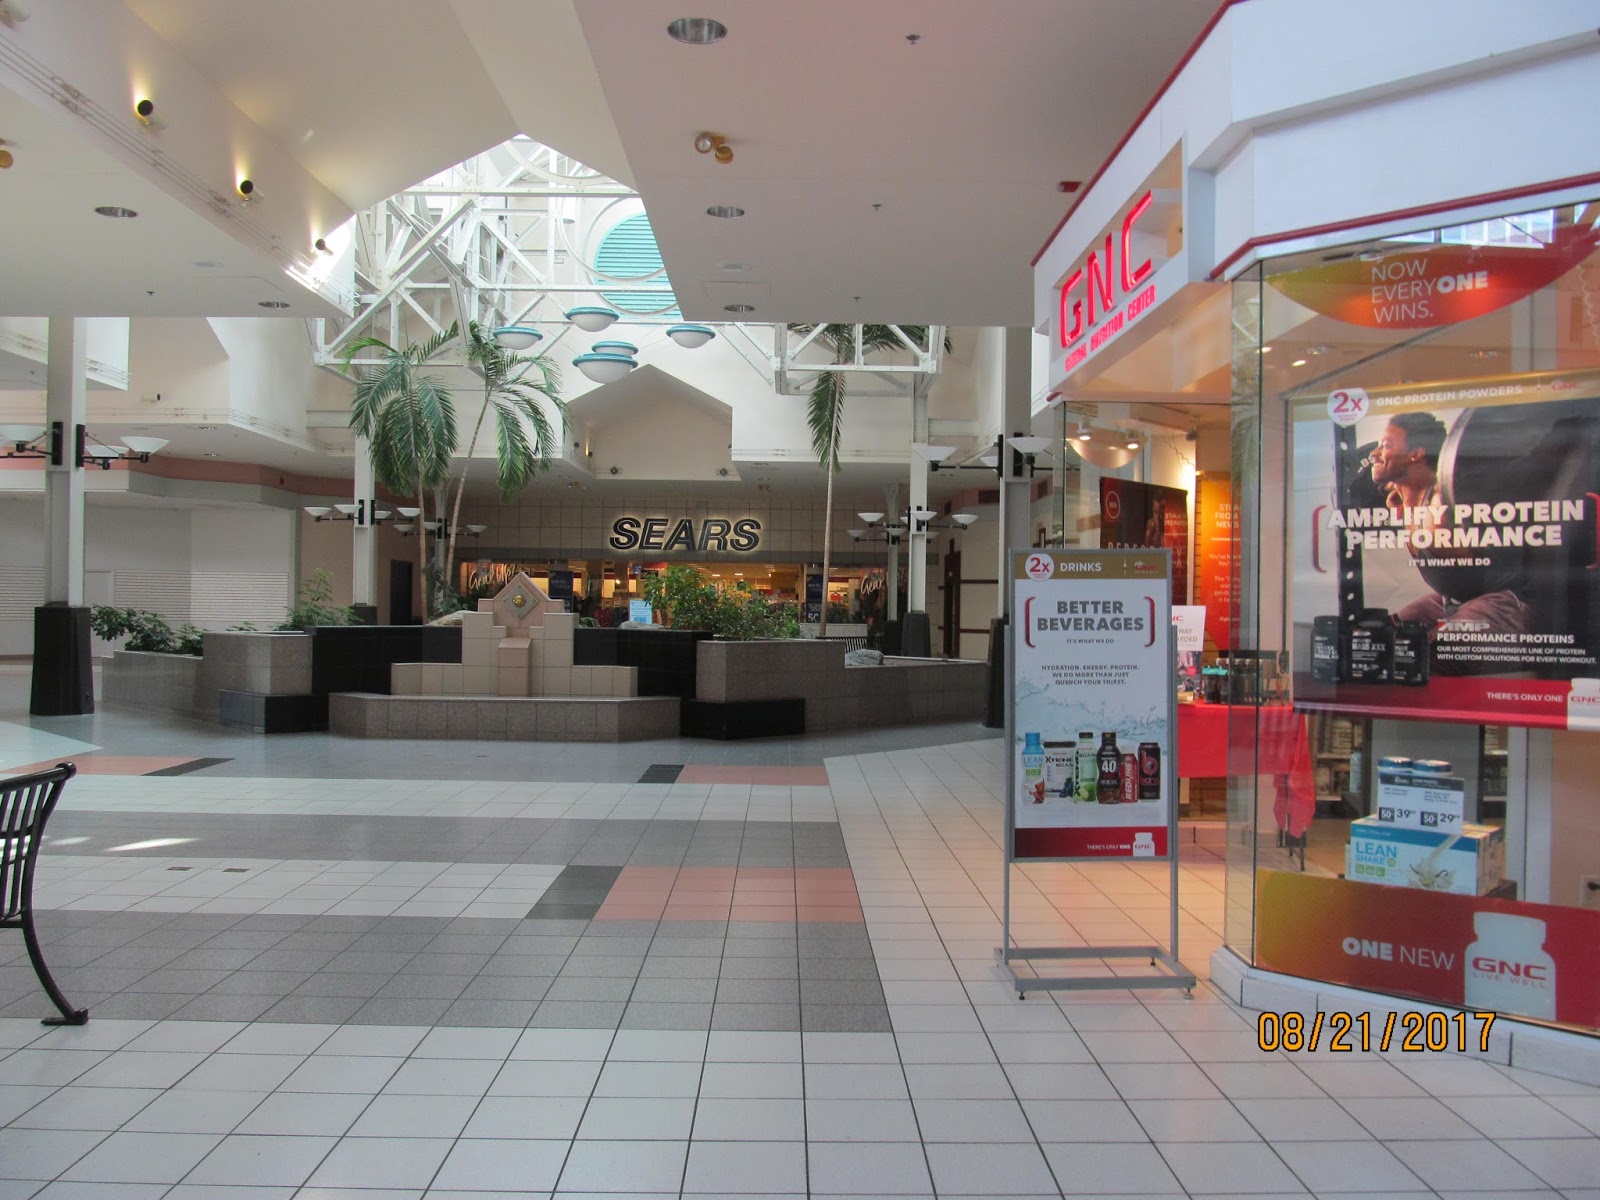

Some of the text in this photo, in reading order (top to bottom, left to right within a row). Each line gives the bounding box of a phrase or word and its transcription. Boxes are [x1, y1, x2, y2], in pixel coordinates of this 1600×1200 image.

[1060, 189, 1153, 348] GNC
[1371, 258, 1427, 282] NOW
[1371, 270, 1488, 303] EVERYONE
[1127, 284, 1156, 321] CENTER
[1374, 301, 1434, 323] WINS.
[1376, 384, 1522, 406] GNC PROTEIN POWDERS
[1327, 499, 1584, 529] AMPLIFY PROTEIN
[609, 517, 761, 551] SEARS
[1347, 524, 1562, 550] PERFORMANCE
[1060, 562, 1102, 572] DRINKS
[1408, 557, 1491, 567] IT'S WHAT WE DO
[1057, 601, 1124, 614] BETTER
[1037, 617, 1144, 631] BEVERAGES
[1437, 619, 1490, 632] AMP
[1437, 633, 1575, 644] PERFORMANCE PROTEINS
[1486, 692, 1519, 700] THERE'S
[1101, 760, 1117, 773] 40
[1356, 841, 1397, 857] LEAN
[1355, 854, 1385, 865] SHAKE
[1342, 937, 1455, 971] ONE NEW
[1472, 957, 1547, 980] GNC
[1472, 972, 1546, 989] LIVE WELL
